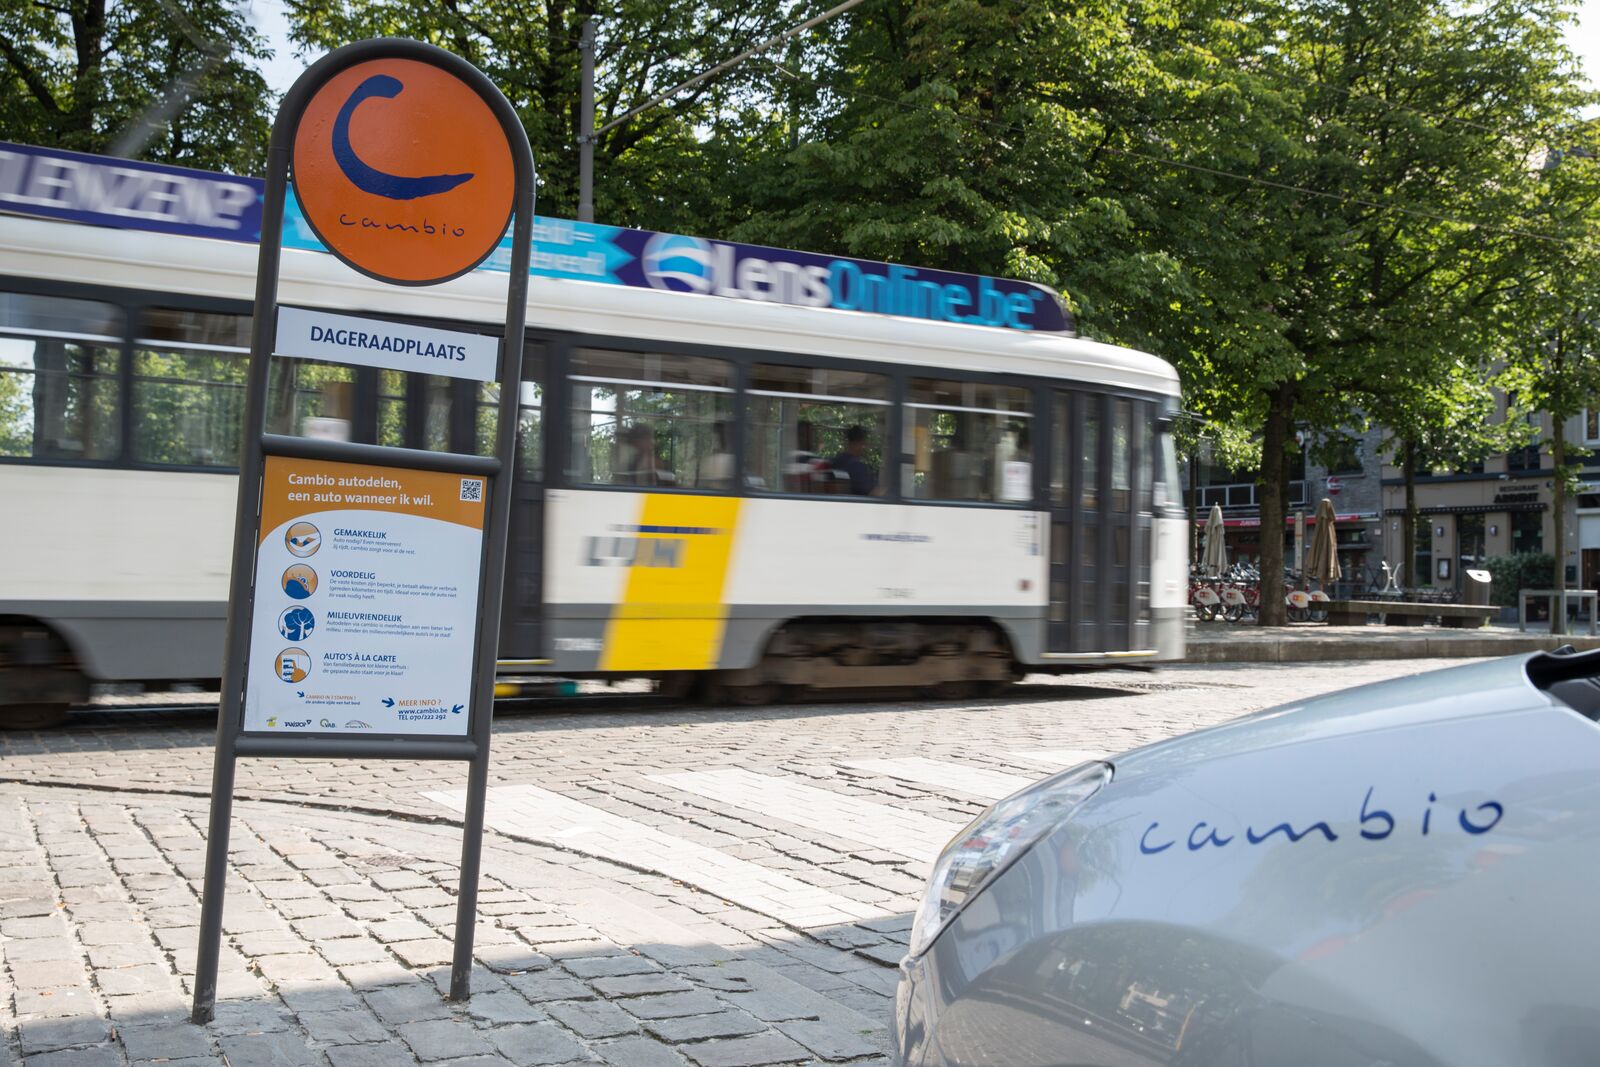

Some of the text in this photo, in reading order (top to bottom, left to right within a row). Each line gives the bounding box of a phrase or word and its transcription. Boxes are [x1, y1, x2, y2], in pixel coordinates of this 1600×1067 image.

[339, 213, 464, 237] cambio
[310, 326, 466, 362] DAGERAADPLAATS
[288, 474, 402, 490] Cambio autodelen,
[288, 491, 434, 506] een auto wanneer ik wil.
[334, 528, 386, 539] GEMAKKELIJK
[330, 570, 375, 579] VOORDELIG
[327, 612, 402, 622] MILIEUVRIENDELIJK
[354, 652, 360, 661] À
[1139, 785, 1504, 855] cambio
